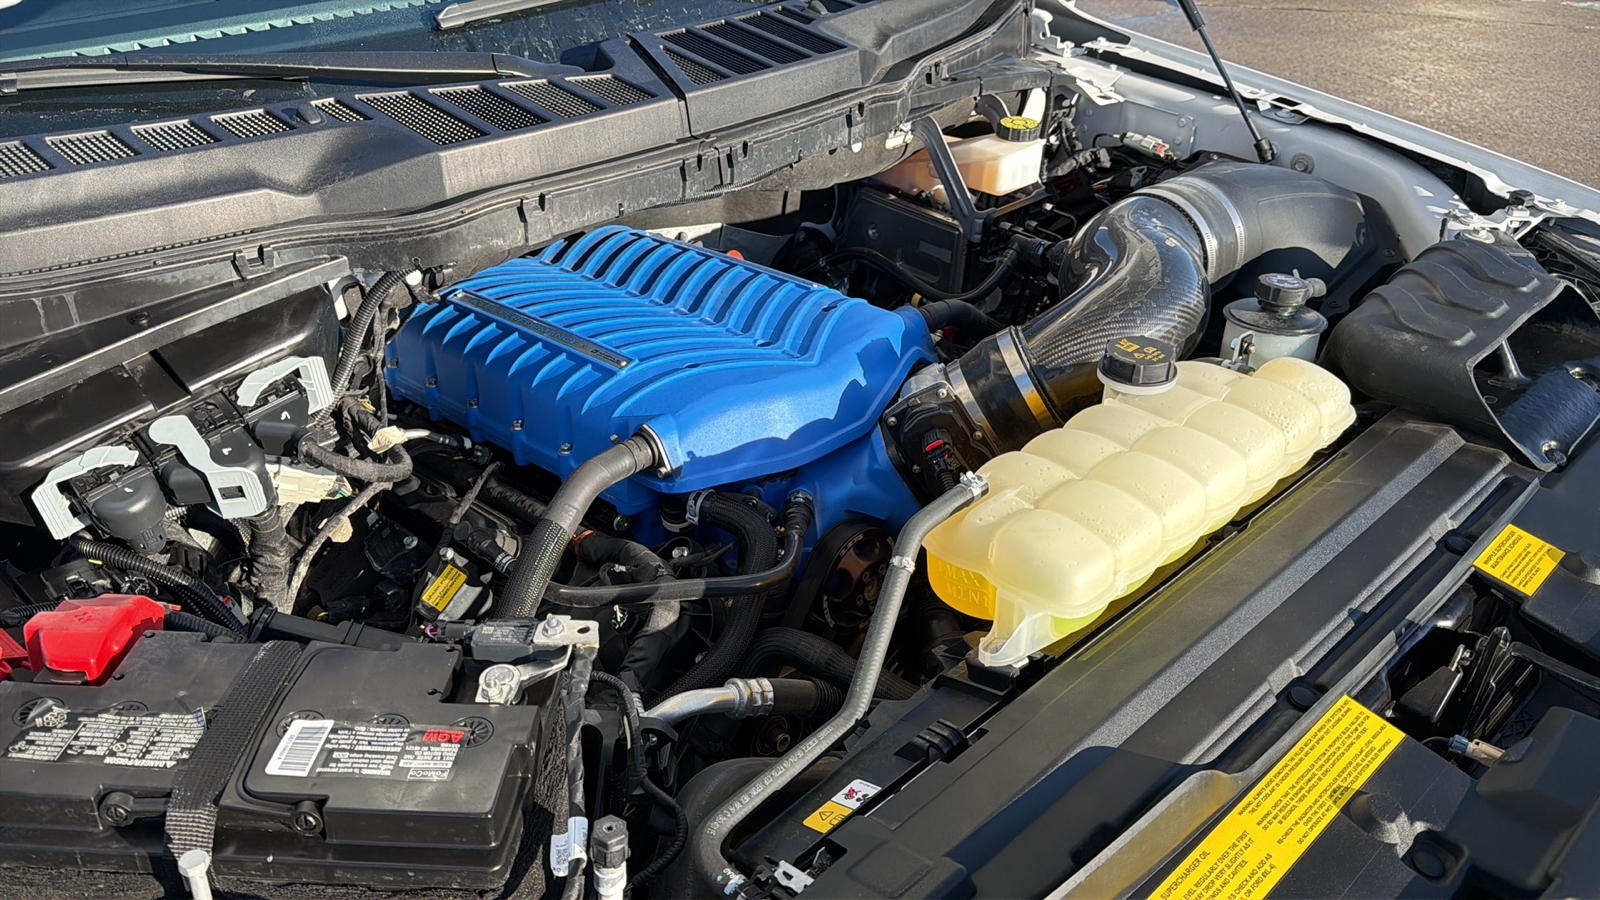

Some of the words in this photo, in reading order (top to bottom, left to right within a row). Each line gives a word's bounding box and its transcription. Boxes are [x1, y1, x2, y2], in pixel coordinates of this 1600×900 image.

[945, 565, 980, 587] MAX
[946, 582, 980, 605] MIN
[422, 732, 463, 743] AGM
[409, 769, 447, 777] FoMoCo
[1159, 857, 1202, 900] SUPERCHARGER
[1198, 848, 1211, 860] OIL
[1180, 885, 1197, 900] EVEL
[1193, 861, 1220, 889] REGULARLY
[1216, 849, 1231, 864] OVER
[1227, 841, 1239, 852] THE
[1235, 829, 1250, 844] FIRST
[1201, 878, 1217, 894] DROP
[1213, 867, 1227, 881] VERY
[1223, 847, 1245, 870] SLIGHTLY
[1241, 841, 1251, 851] AS
[1233, 877, 1250, 895] CHECK
[1246, 868, 1259, 880] AND
[1255, 858, 1267, 871] ADD
[1263, 852, 1273, 861] AS
[1218, 876, 1231, 889] AND
[1243, 887, 1254, 898] OR
[1249, 875, 1265, 891] FORD
